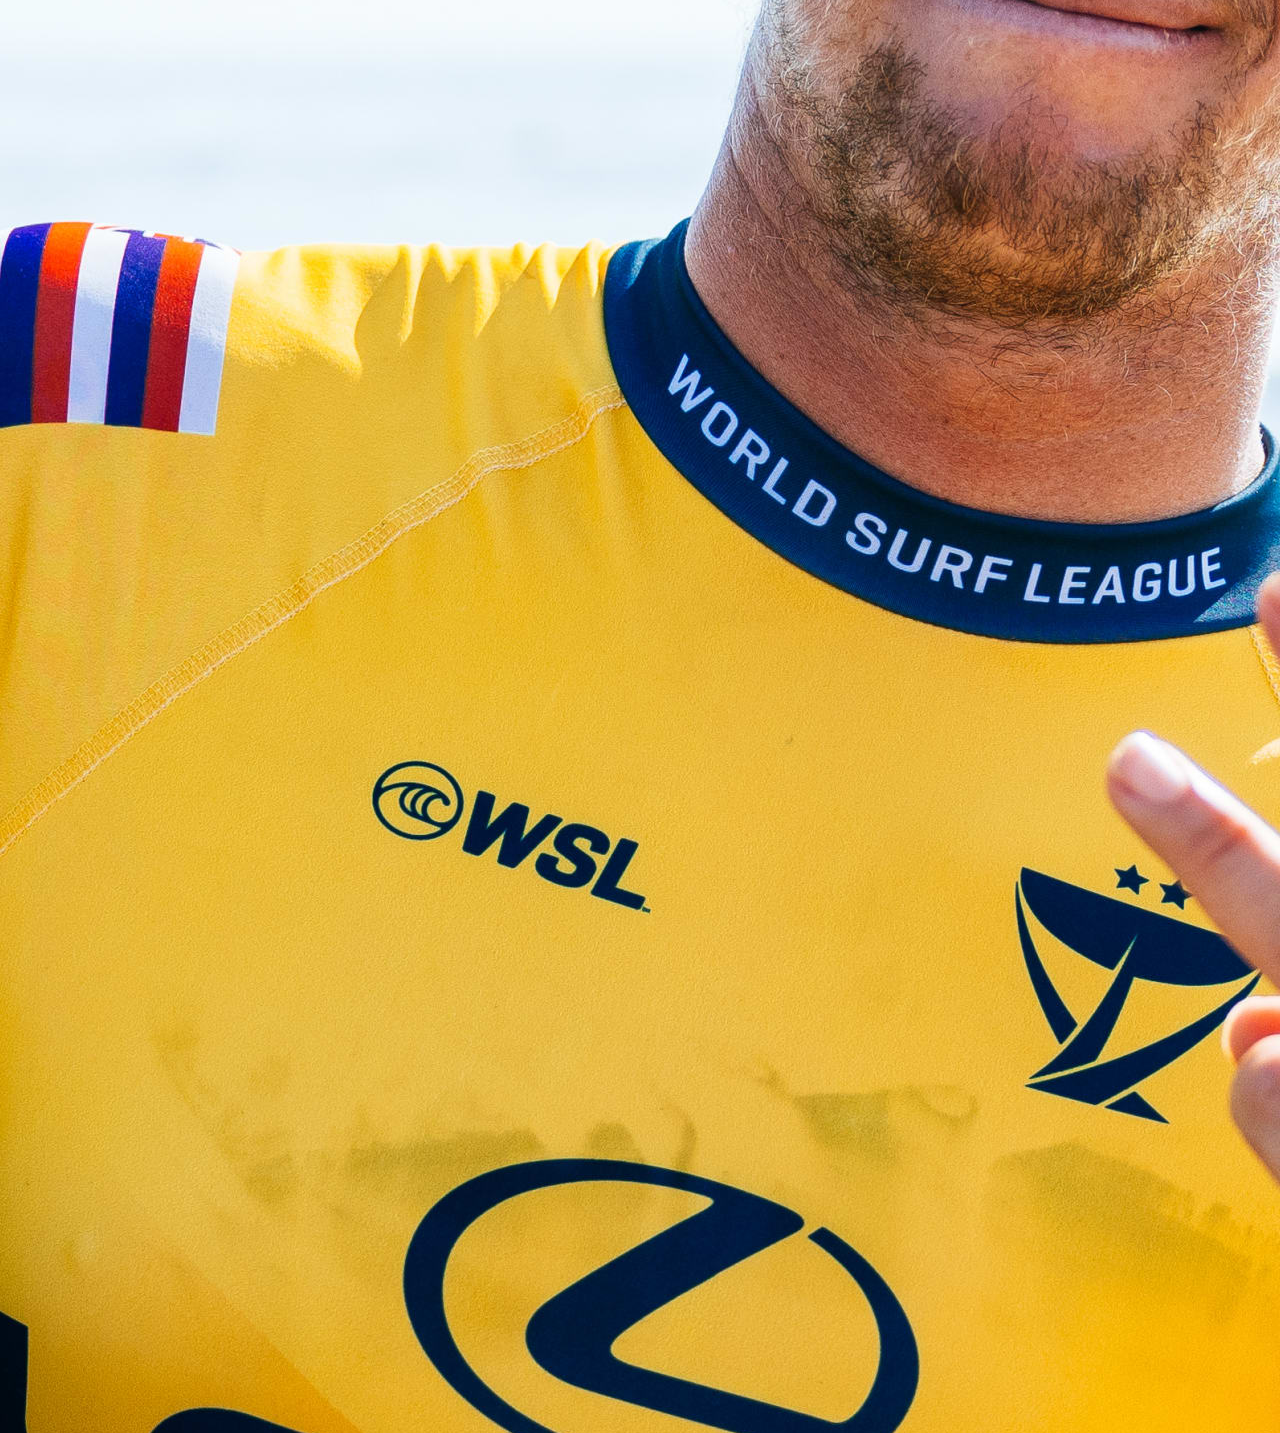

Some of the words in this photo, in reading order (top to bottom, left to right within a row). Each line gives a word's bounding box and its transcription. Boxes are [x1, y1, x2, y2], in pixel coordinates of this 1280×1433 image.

[668, 354, 837, 527] WORLD
[846, 512, 1013, 593] SURF
[1024, 547, 1226, 603] LEAGUE
[463, 790, 646, 911] WSL
